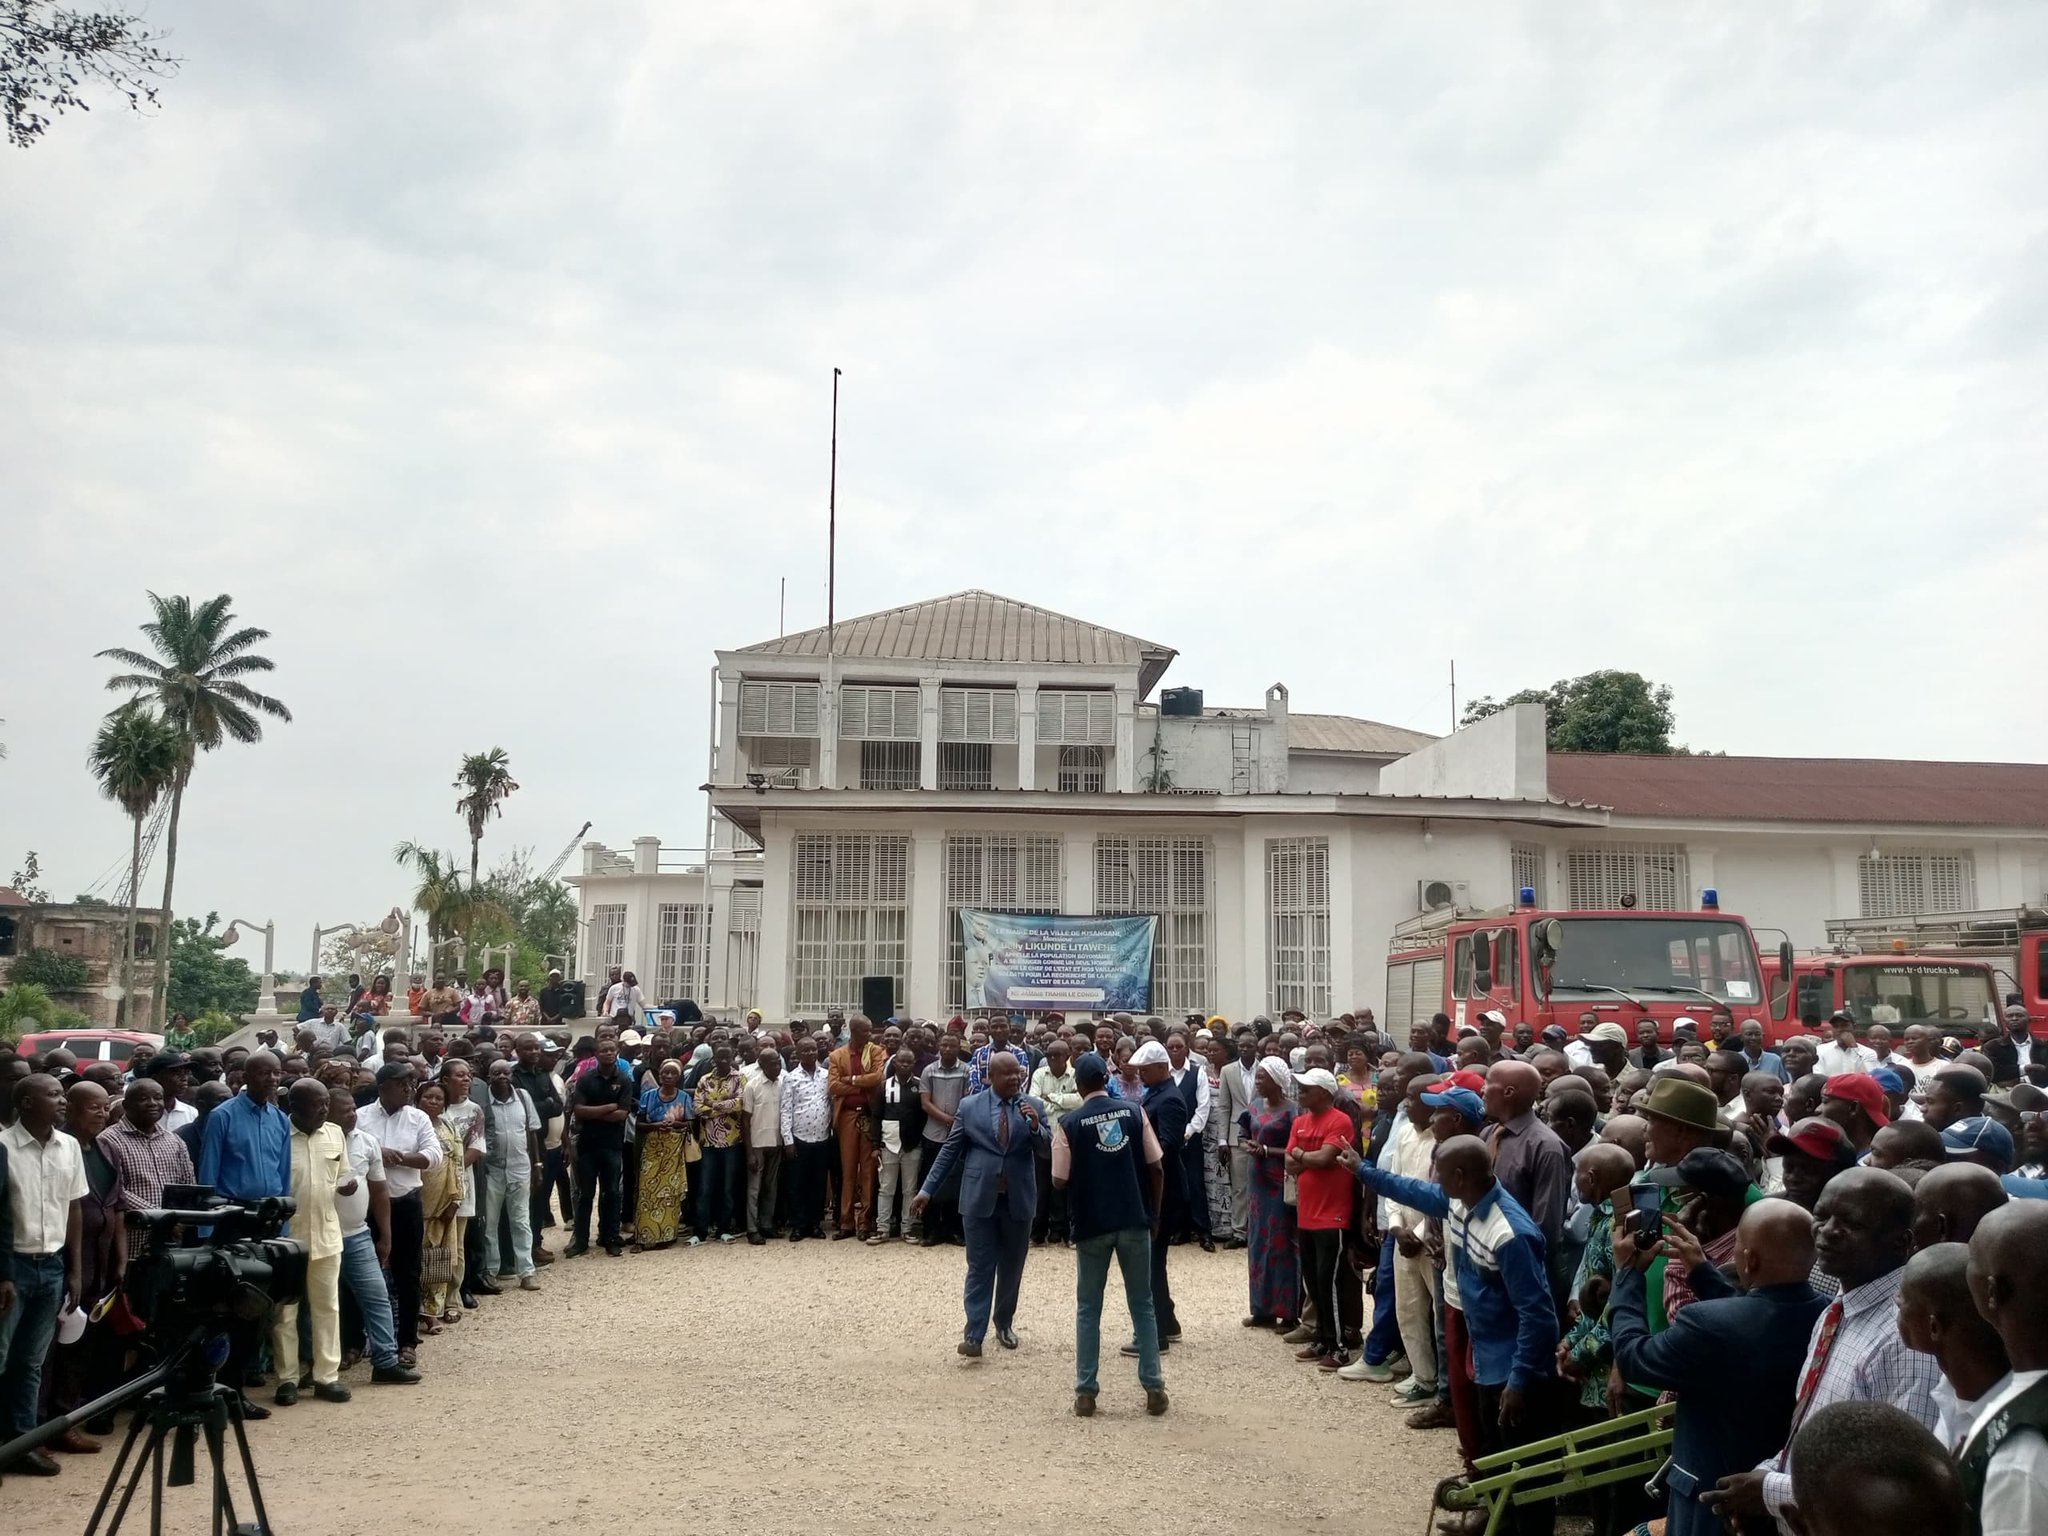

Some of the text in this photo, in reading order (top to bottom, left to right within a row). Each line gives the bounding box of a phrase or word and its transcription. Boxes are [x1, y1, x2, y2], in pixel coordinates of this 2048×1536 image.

[1025, 943, 1067, 951] LIKUNDE
[1069, 943, 1117, 952] LITAWEHE
[1080, 1113, 1108, 1127] PRESSE
